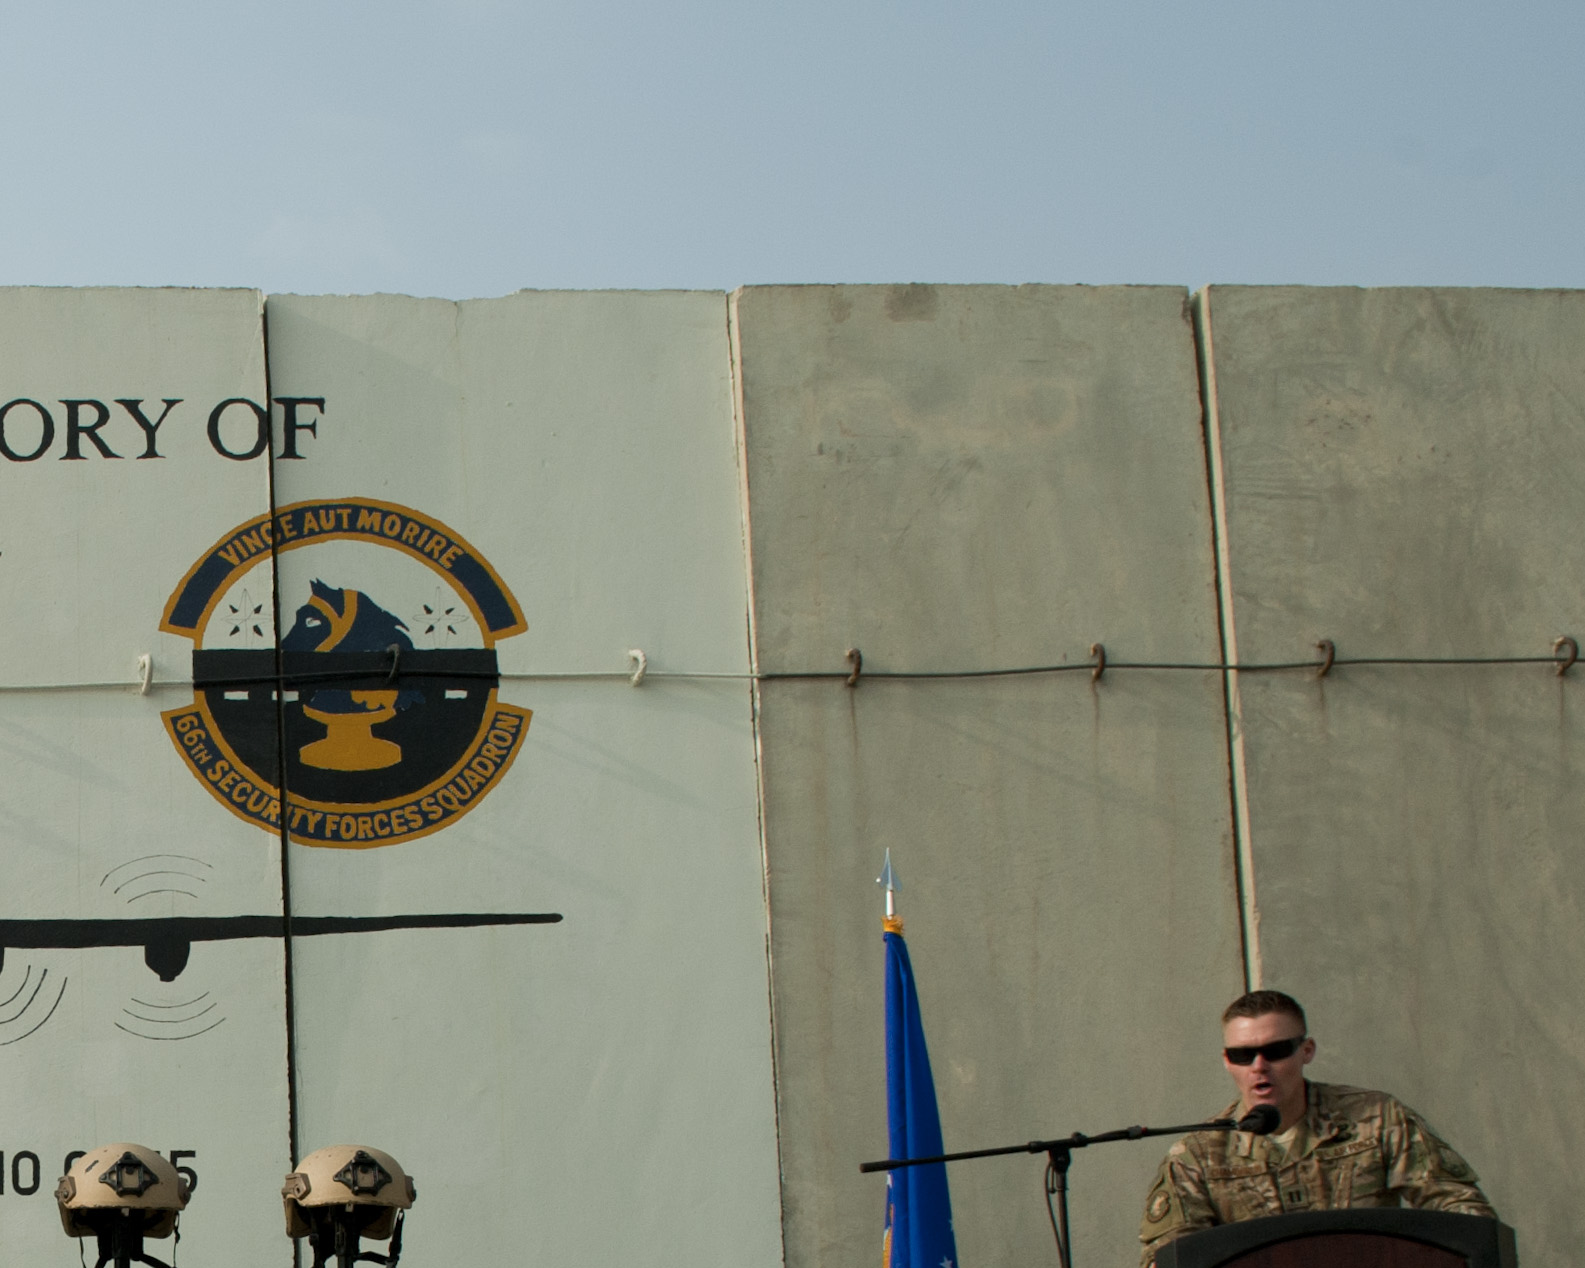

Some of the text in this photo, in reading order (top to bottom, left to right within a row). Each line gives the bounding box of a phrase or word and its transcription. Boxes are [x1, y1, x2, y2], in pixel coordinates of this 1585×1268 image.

[206, 397, 326, 462] OF
[218, 508, 464, 571] VINCE AUT MORIRE
[326, 806, 424, 840] FORCES
[420, 714, 523, 821] SQUADRON
